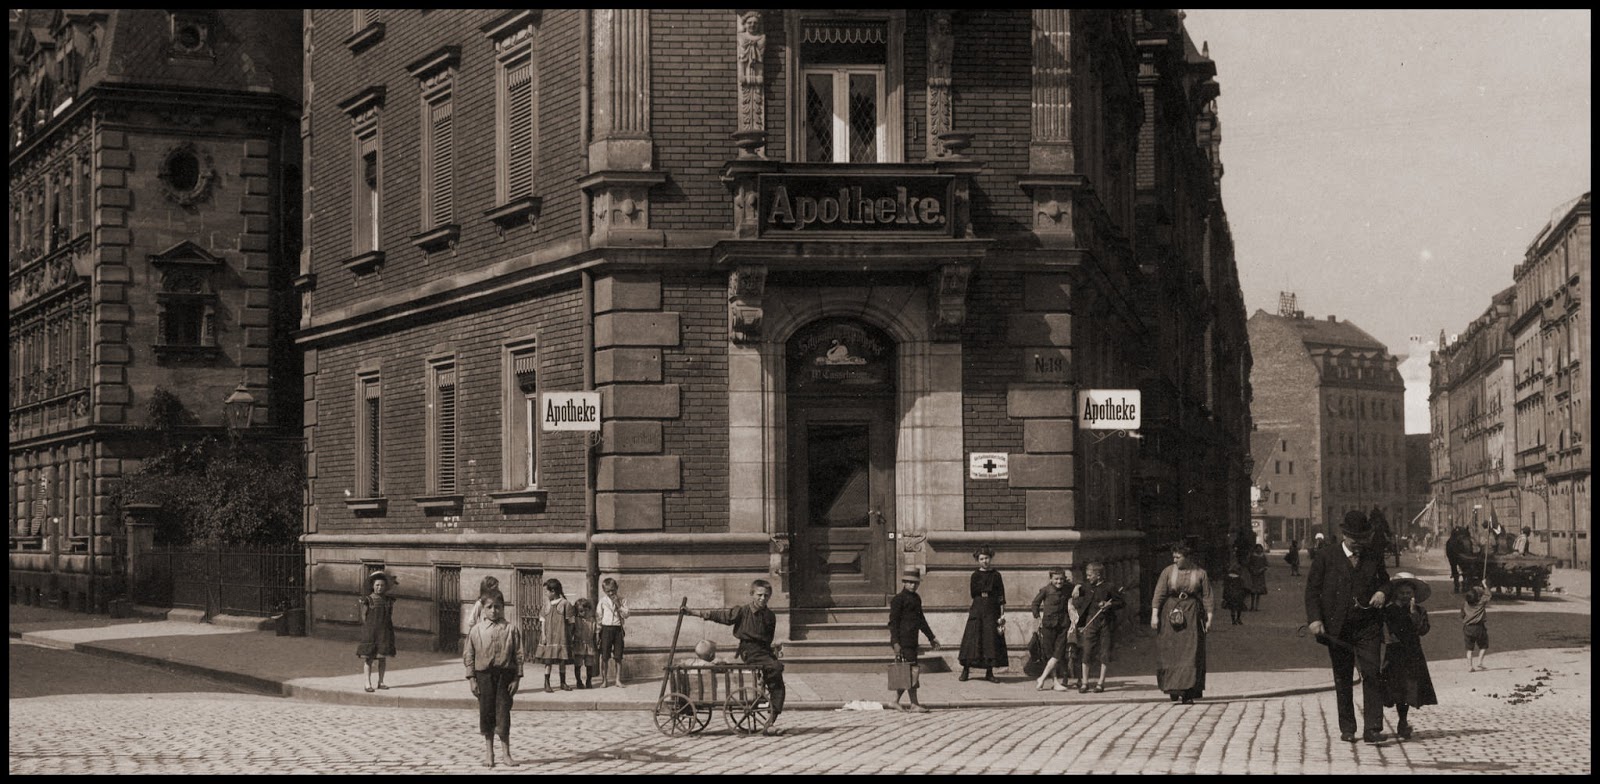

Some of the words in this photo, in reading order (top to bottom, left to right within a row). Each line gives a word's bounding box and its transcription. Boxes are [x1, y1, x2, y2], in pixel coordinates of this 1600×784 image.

[768, 186, 946, 231] Apotheke.
[545, 398, 596, 426] Apotheke
[1083, 397, 1136, 424] Apotheke
